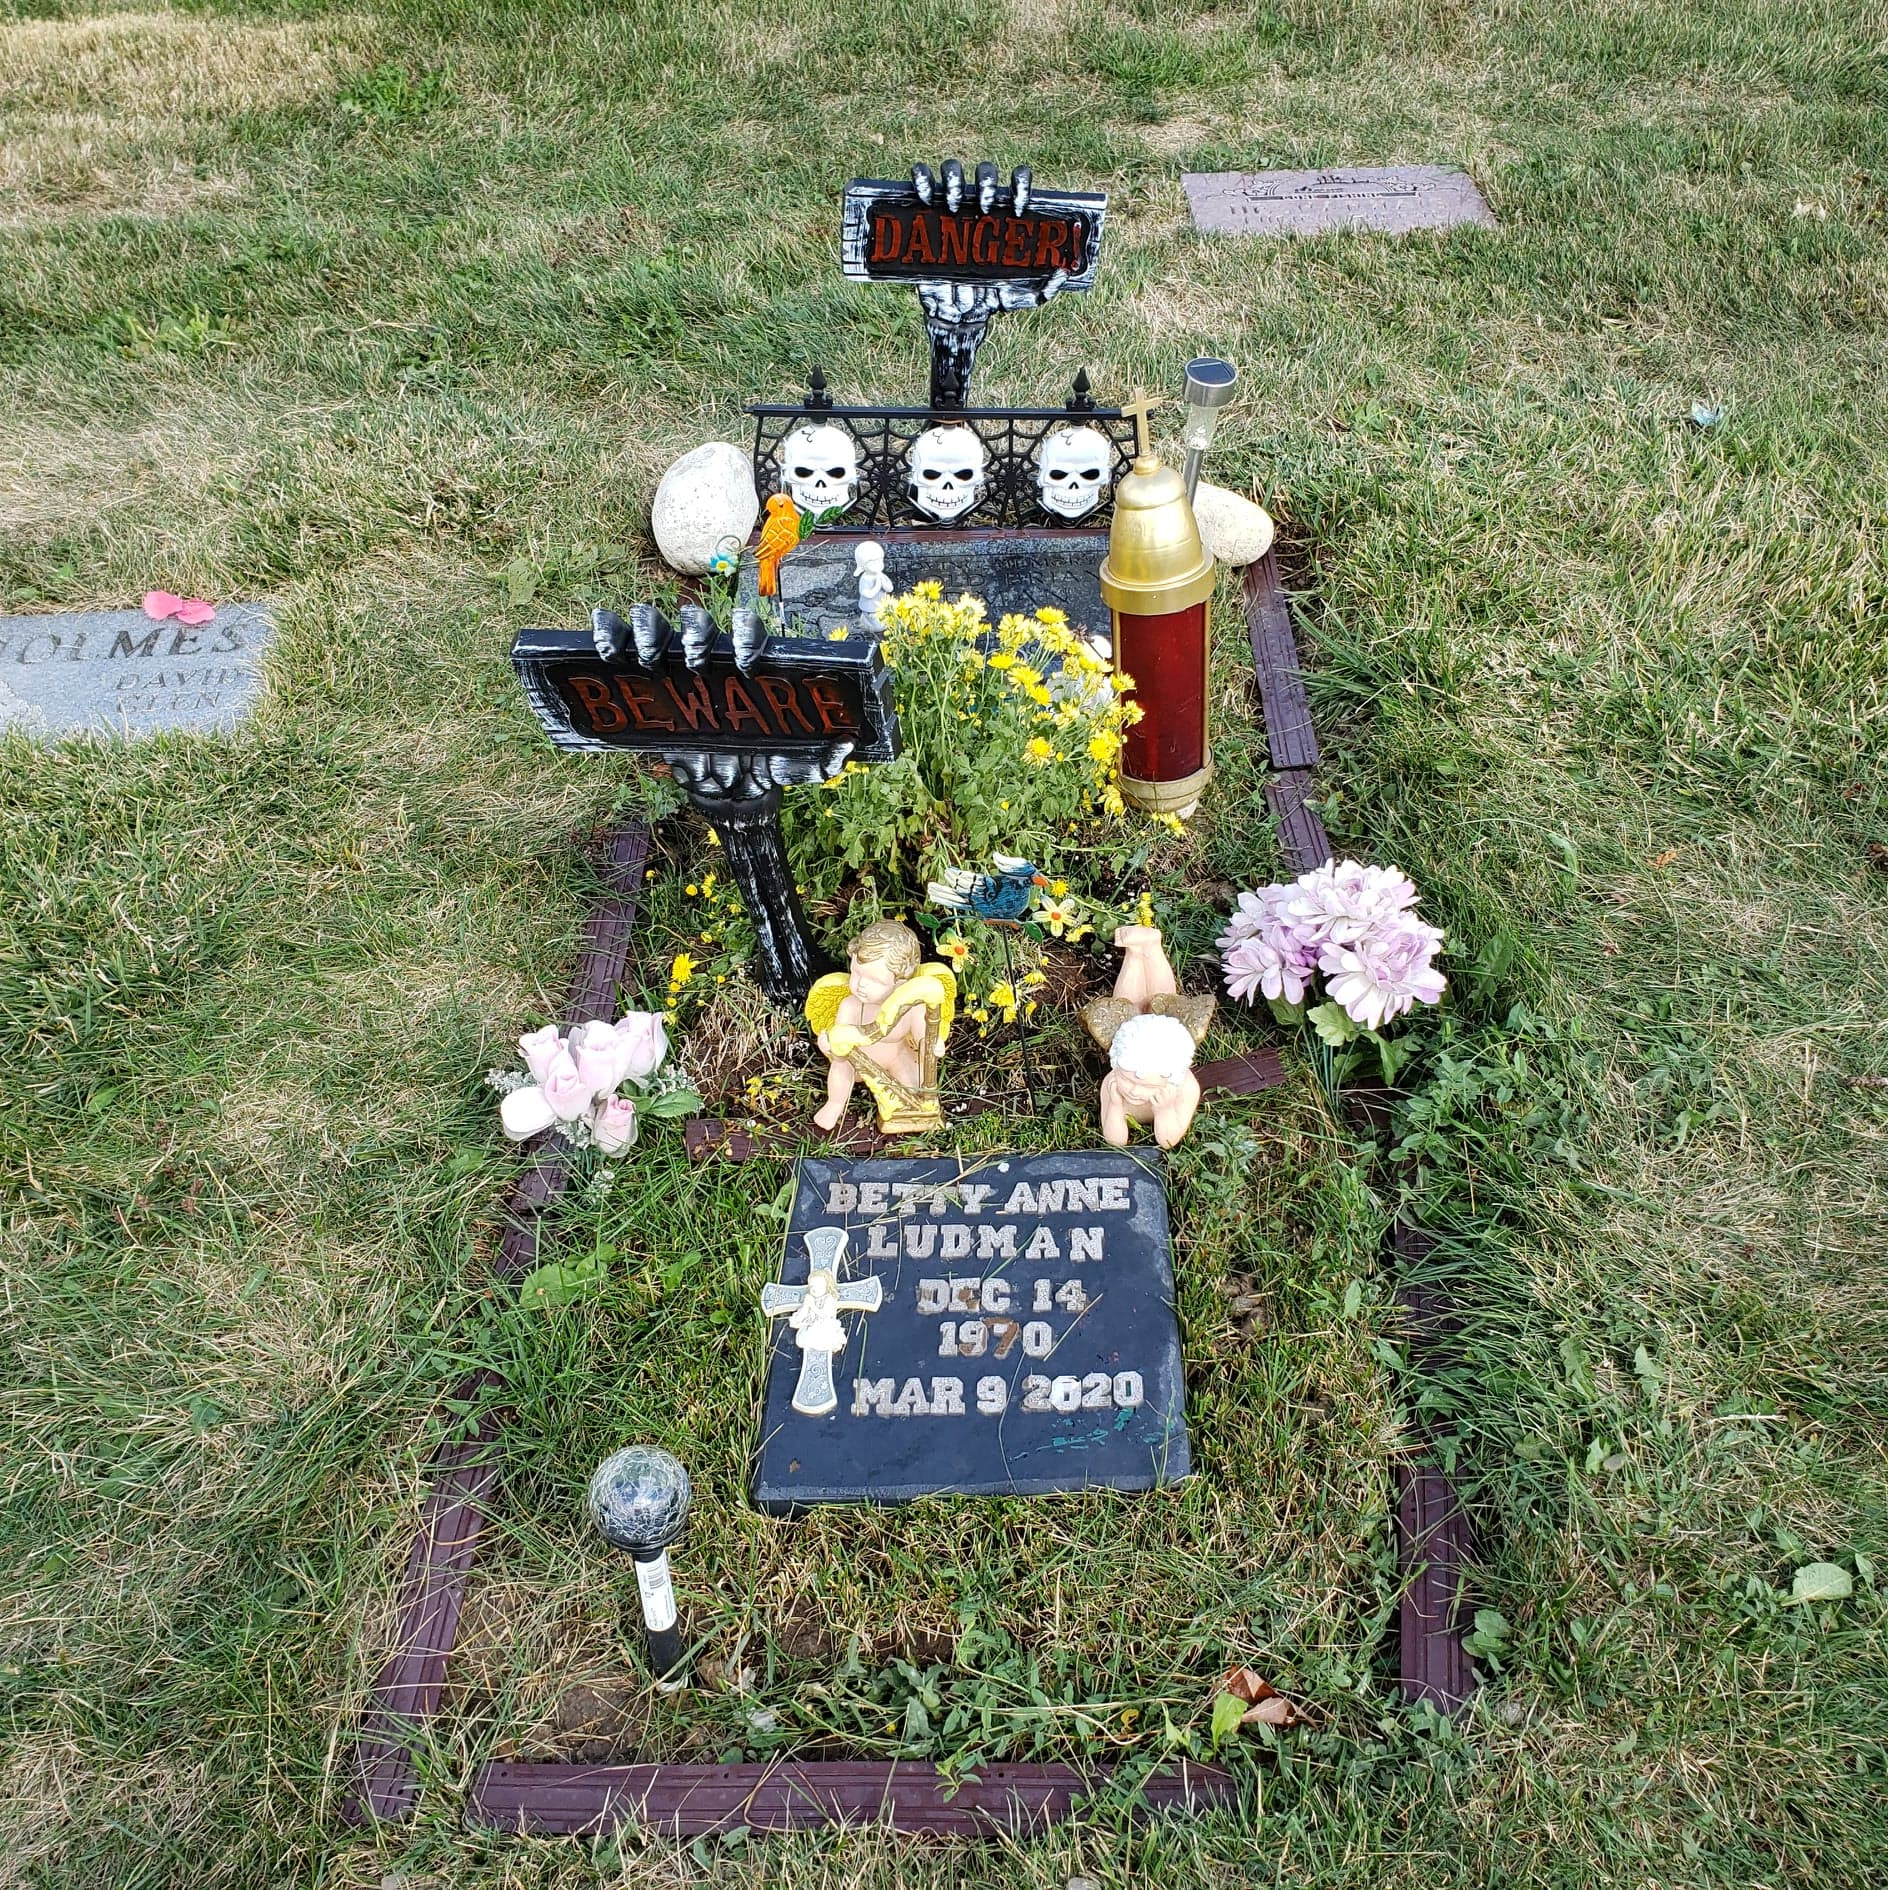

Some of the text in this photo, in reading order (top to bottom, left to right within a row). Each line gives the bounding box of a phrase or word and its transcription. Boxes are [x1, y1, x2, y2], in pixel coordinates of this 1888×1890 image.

[870, 214, 1082, 272] DANGER!
[0, 625, 248, 664] OLMES
[568, 676, 860, 736] BEWARE
[826, 1177, 1130, 1215] BETTY ANNE
[867, 1224, 1105, 1262] LUDMAN
[917, 1279, 1087, 1314] DEC 14
[938, 1318, 1054, 1358] 1970
[851, 1371, 1145, 1416] MAR 9 2020
